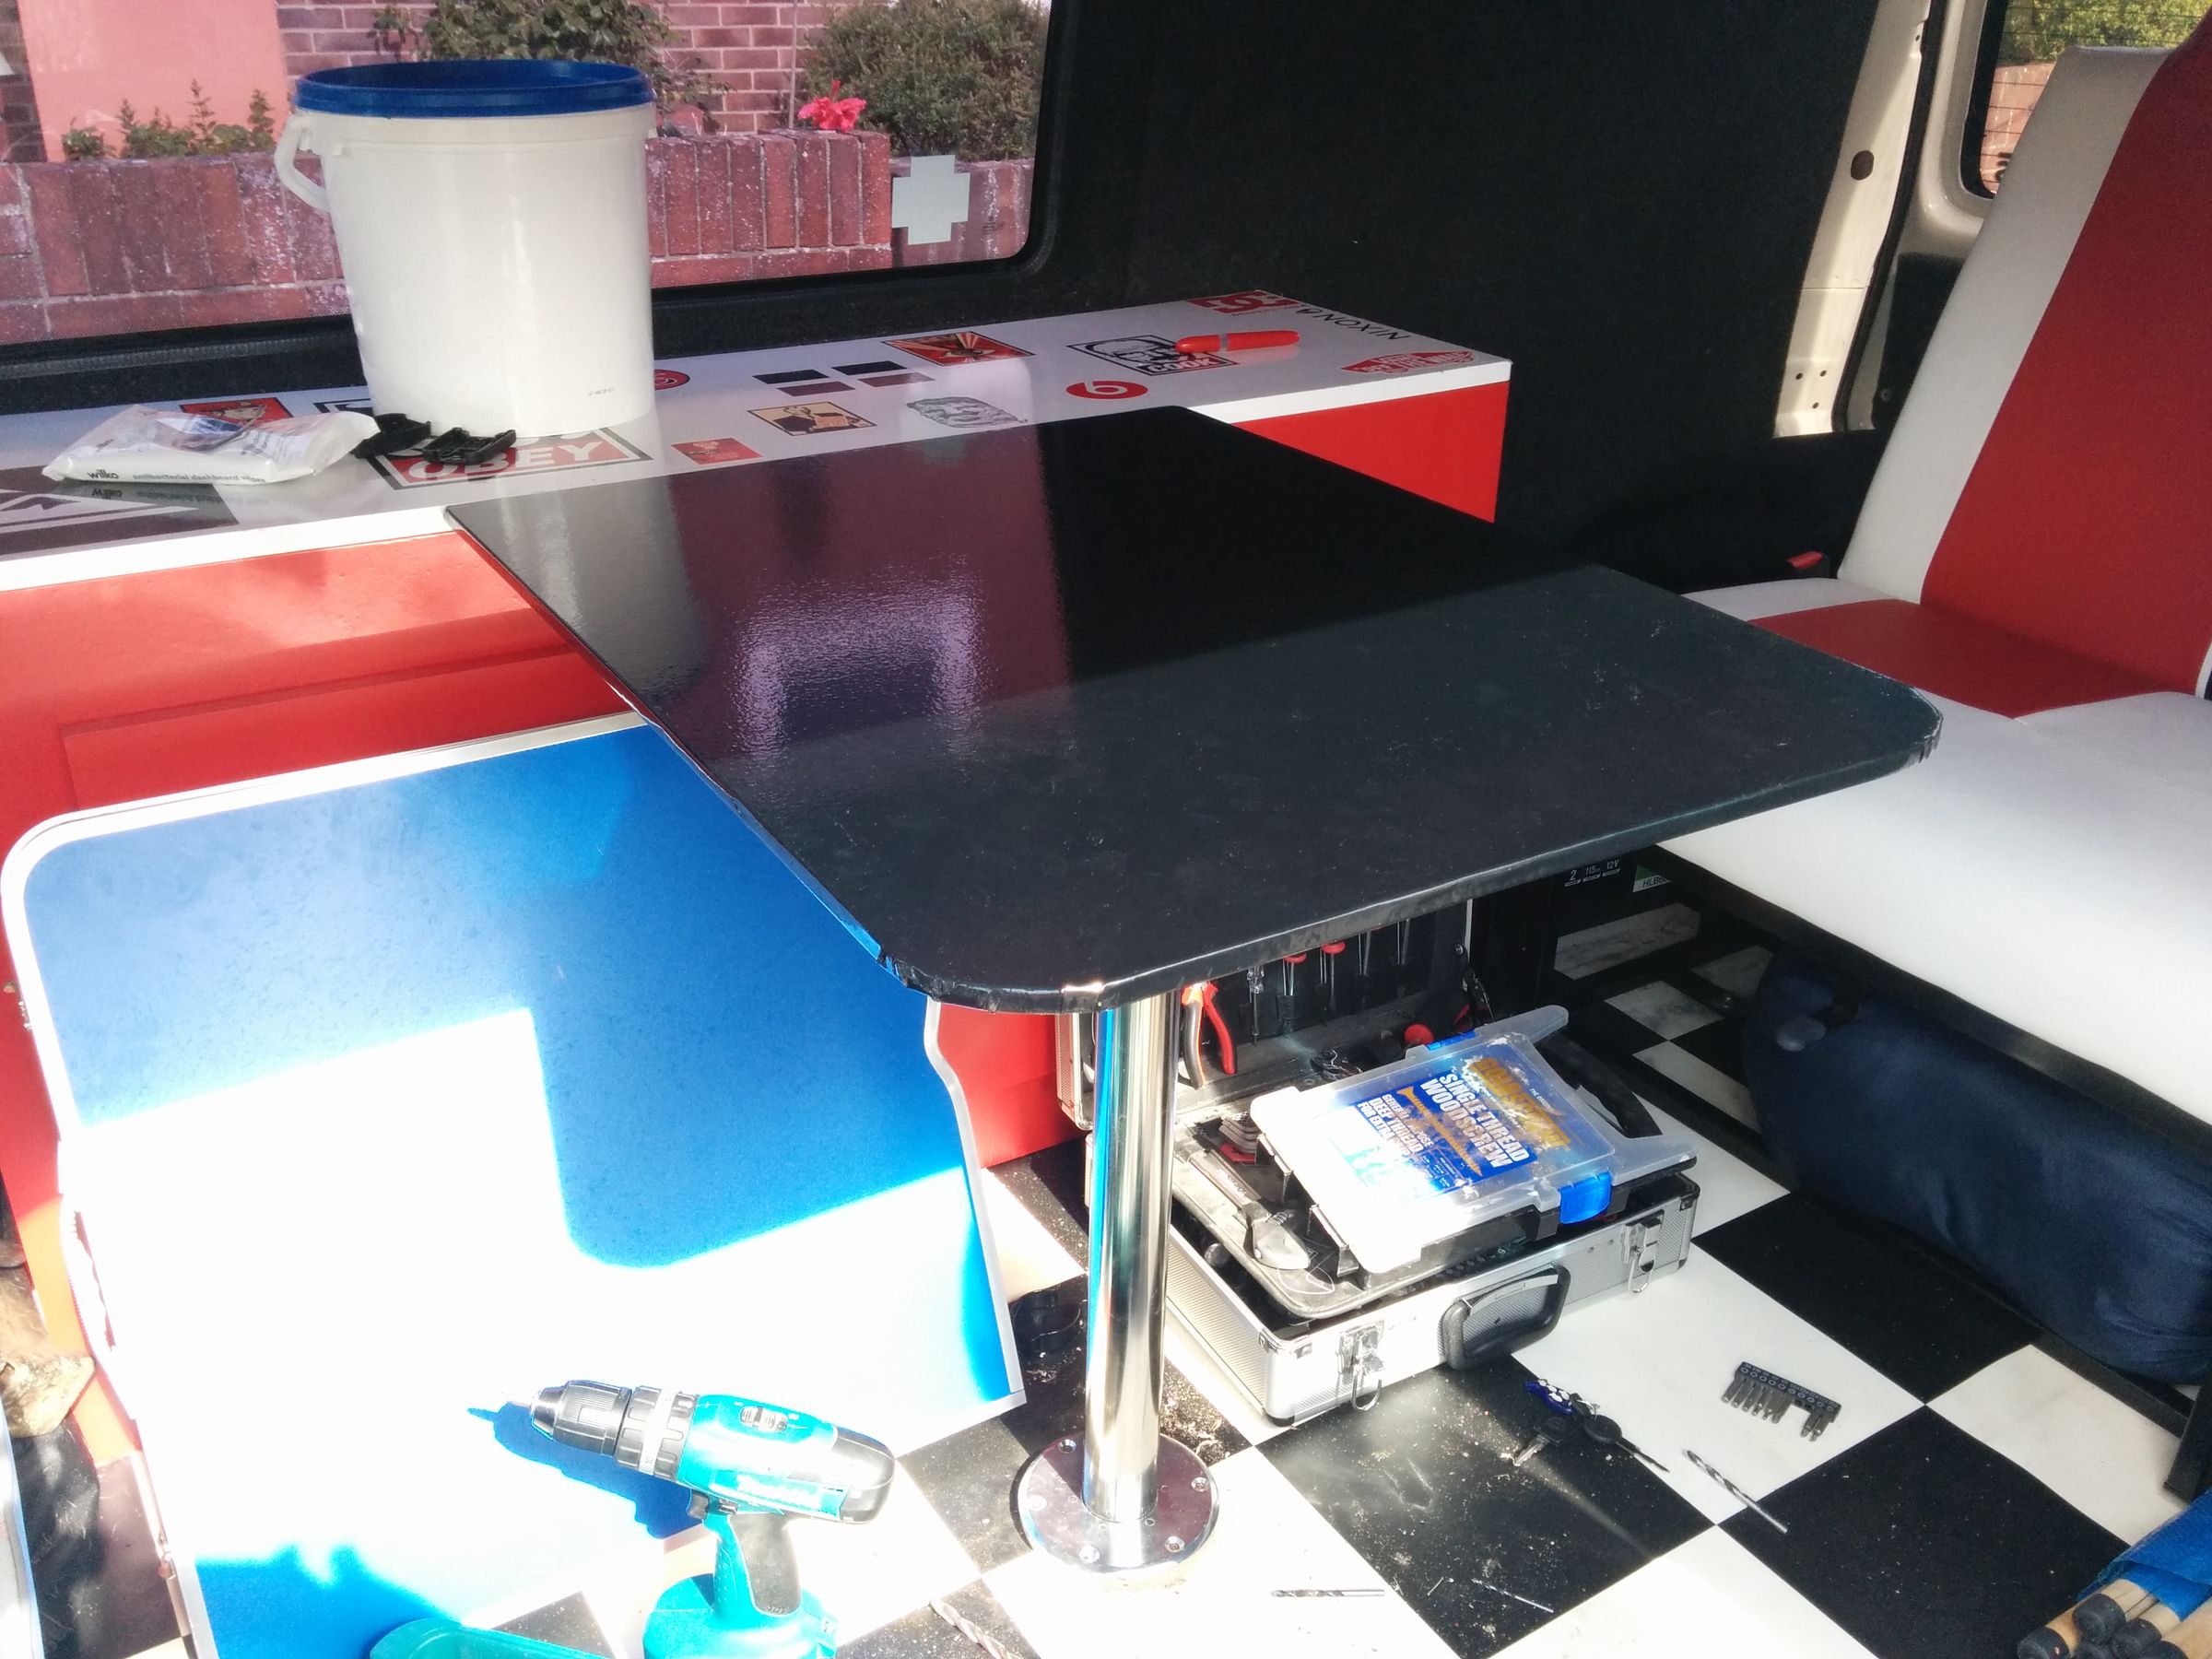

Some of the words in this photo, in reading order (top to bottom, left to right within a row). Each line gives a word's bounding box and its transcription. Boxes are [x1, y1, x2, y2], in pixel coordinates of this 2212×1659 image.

[1314, 313, 1411, 340] NIXON
[1147, 358, 1217, 373] COOK
[88, 468, 120, 479] wilko
[190, 473, 239, 481] dashboard
[408, 441, 604, 478] OBEY
[1606, 858, 1620, 870] 12V
[1368, 1097, 1395, 1119] DEEP
[1386, 1116, 1425, 1154] THREAD
[1420, 1077, 1513, 1169] WOODSCREW
[1439, 1073, 1487, 1115] SINGLE
[1477, 1108, 1530, 1163] THREAD
